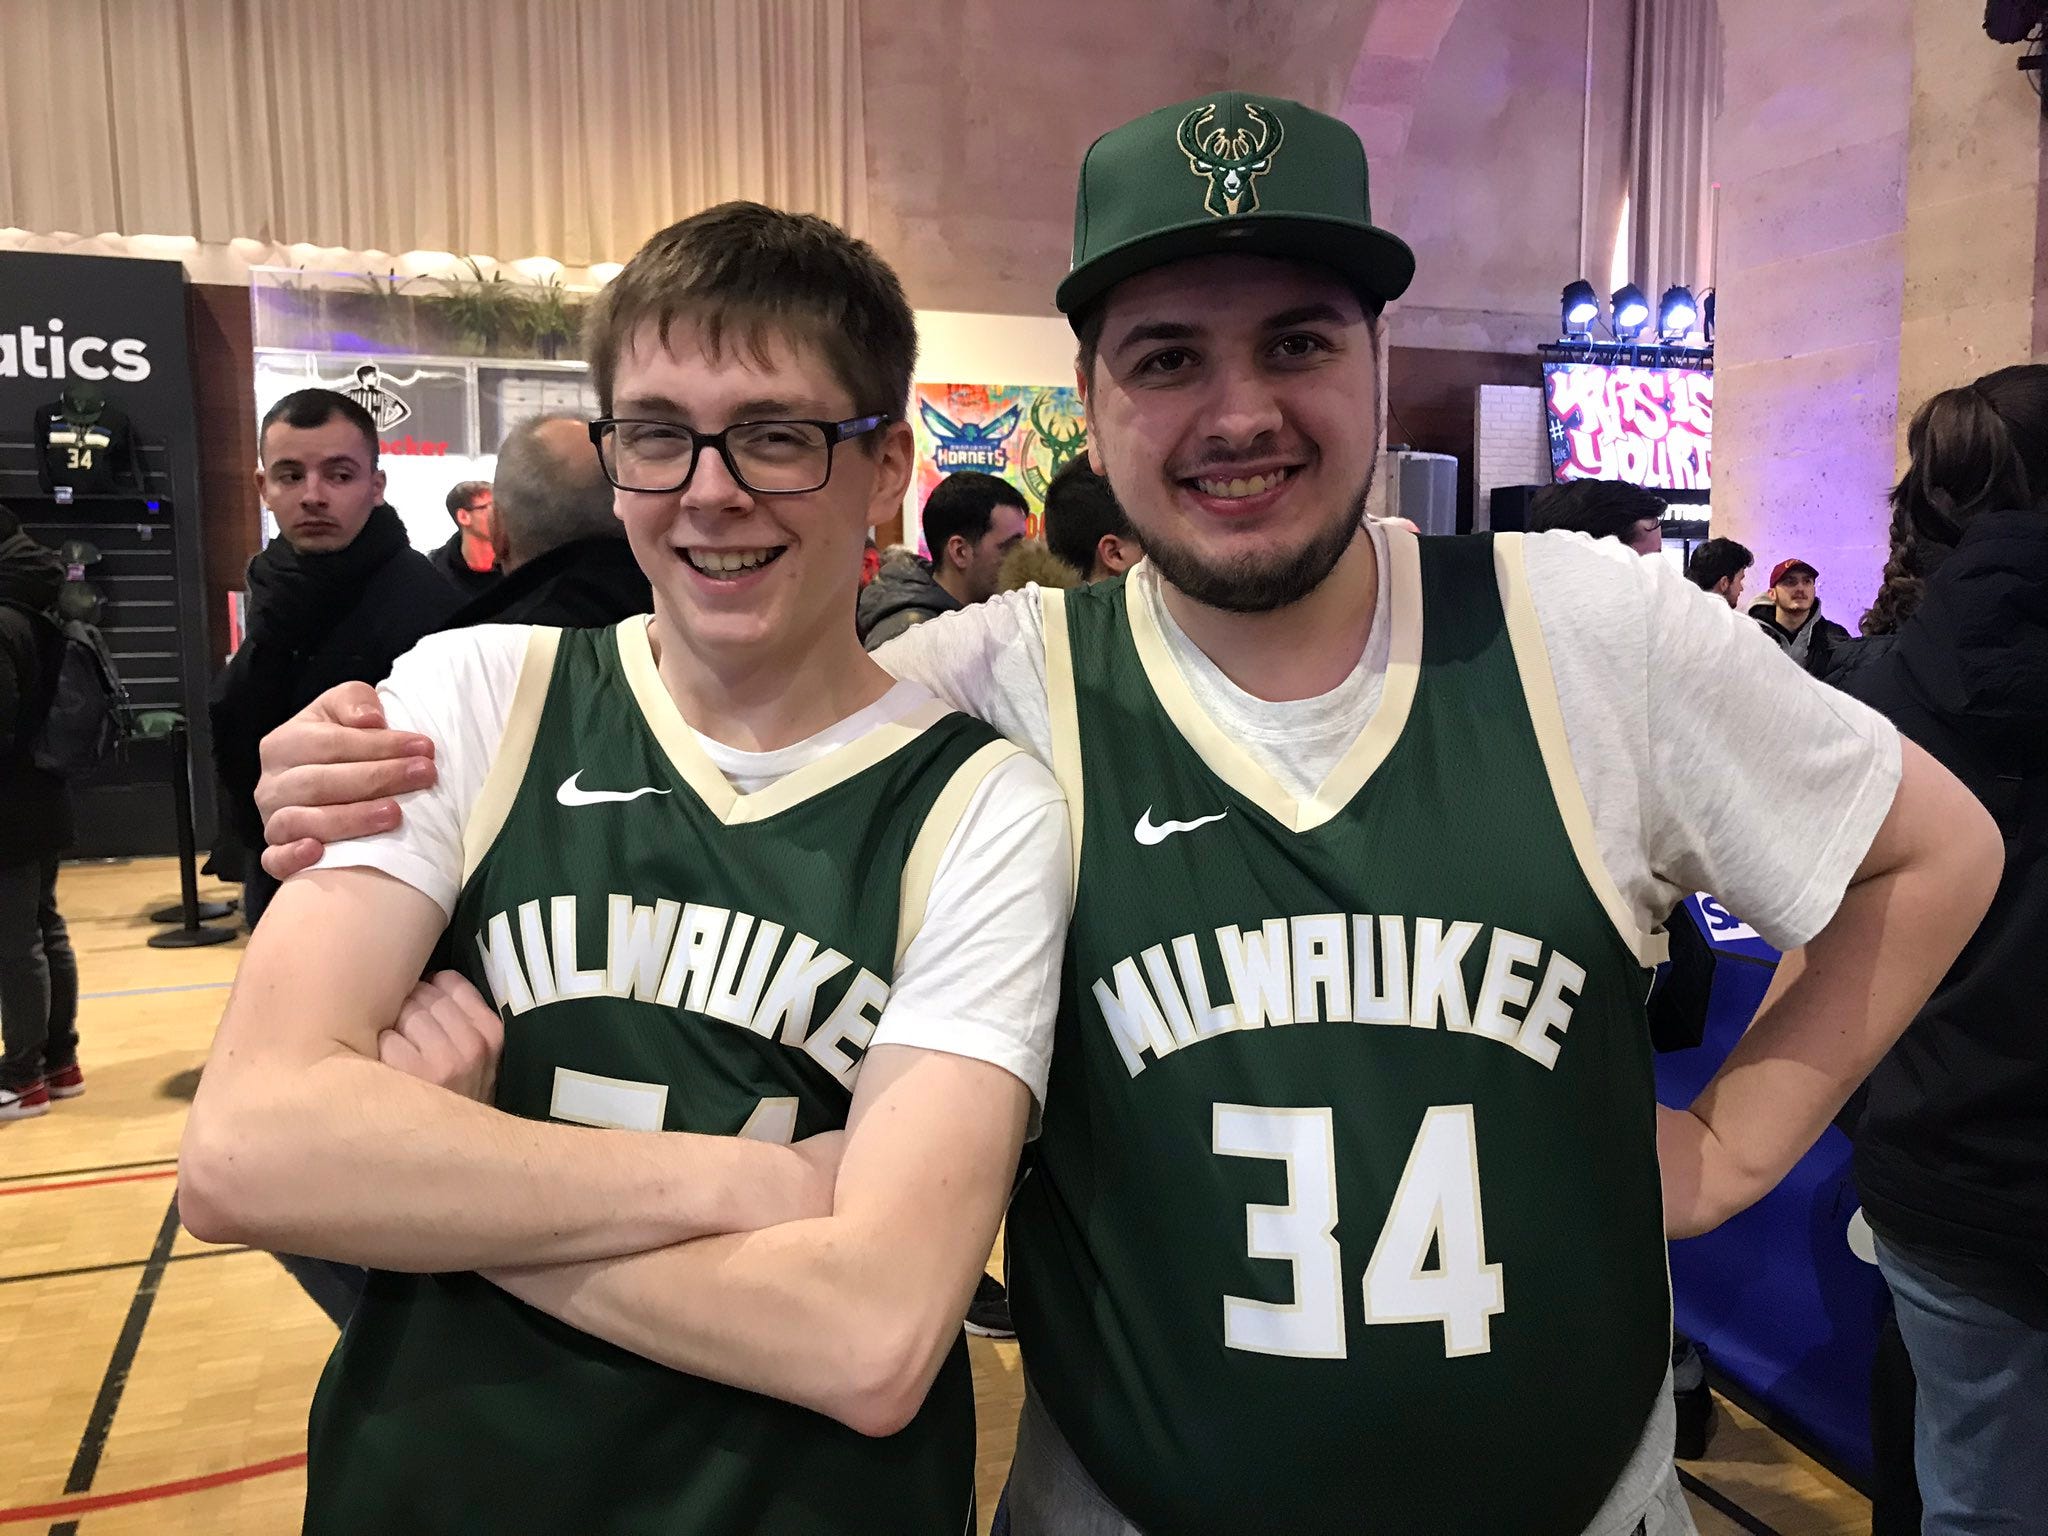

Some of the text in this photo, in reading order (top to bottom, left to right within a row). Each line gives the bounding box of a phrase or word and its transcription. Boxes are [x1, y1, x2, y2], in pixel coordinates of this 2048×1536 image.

[66, 448, 92, 469] 34
[937, 448, 1004, 467] HORNETS
[475, 893, 892, 1091] MILWAUKE
[1092, 913, 1587, 1079] MILWAUKEE
[1212, 1102, 1505, 1360] 34
